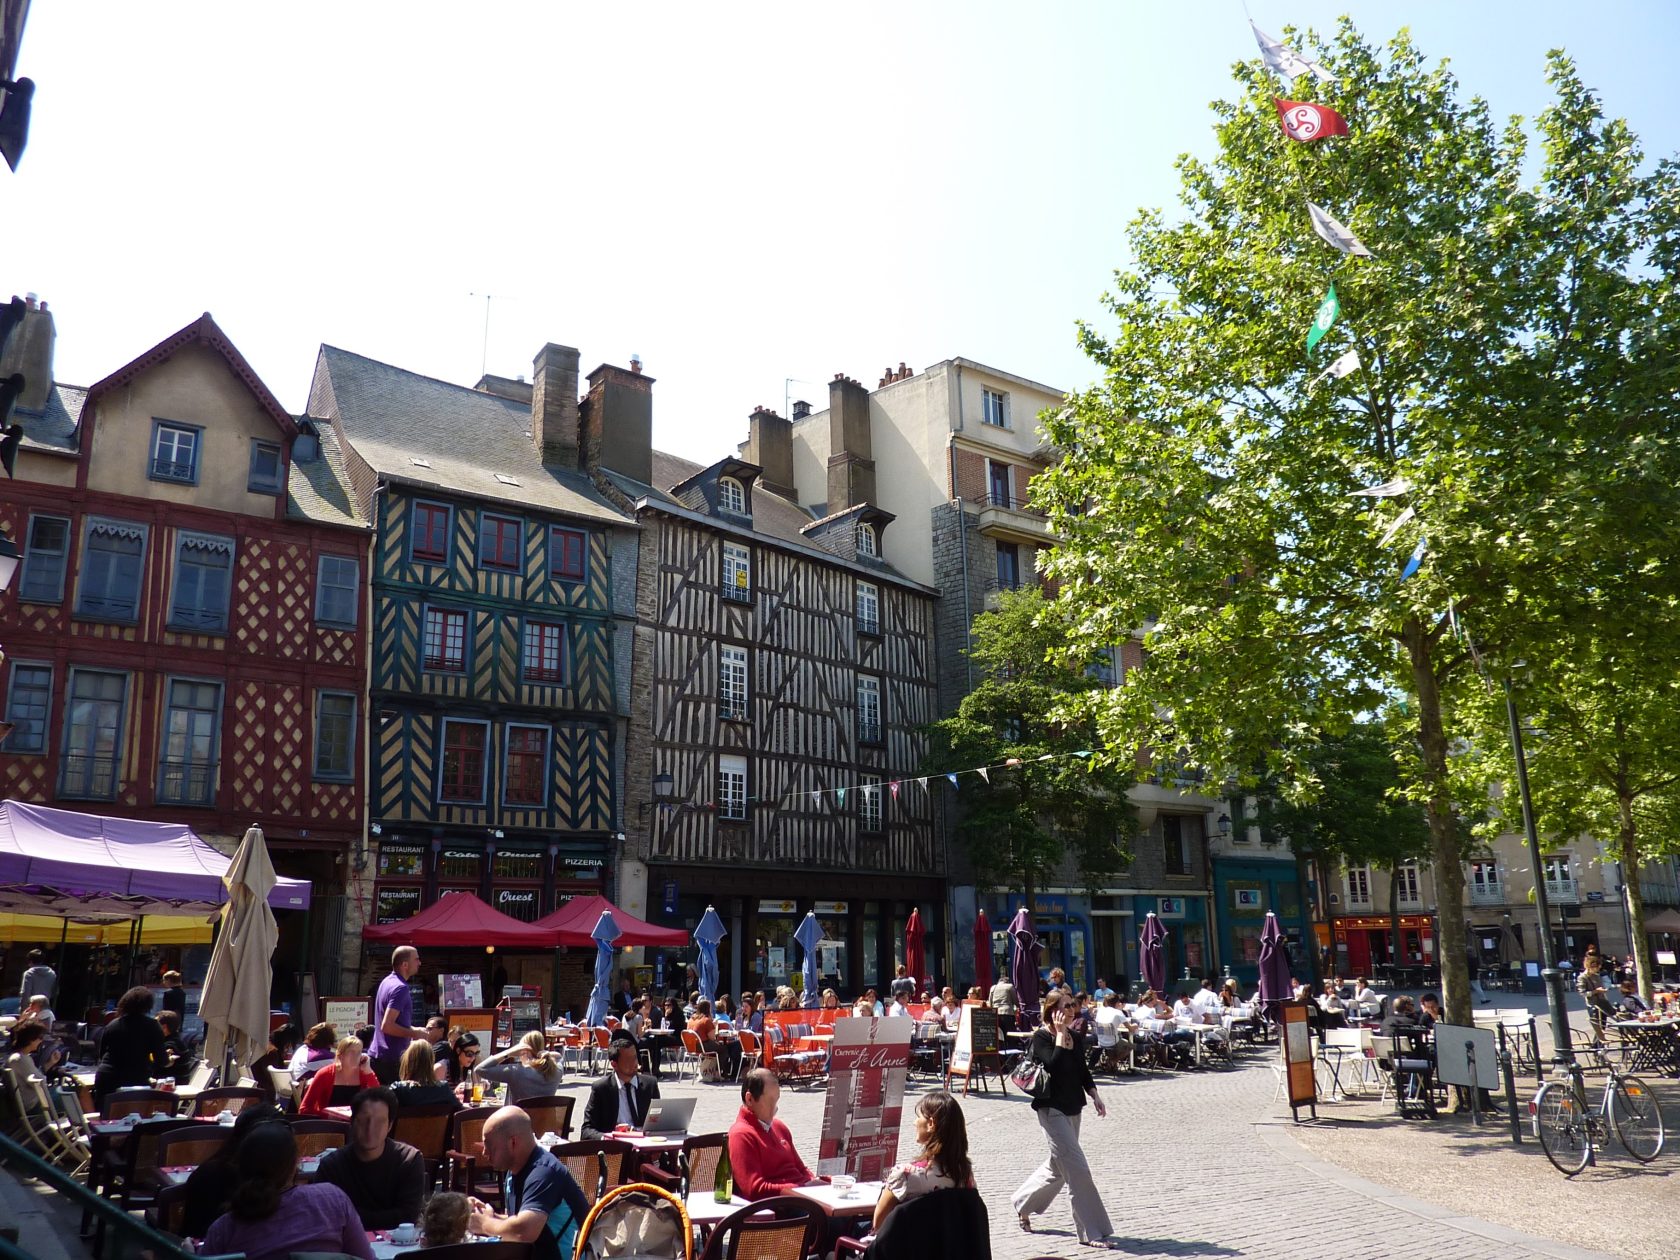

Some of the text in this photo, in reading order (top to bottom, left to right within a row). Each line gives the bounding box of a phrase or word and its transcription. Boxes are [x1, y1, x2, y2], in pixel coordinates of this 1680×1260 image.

[382, 846, 424, 854] RESTAURANT
[500, 890, 534, 903] Ouest
[870, 1048, 908, 1067] Anne
